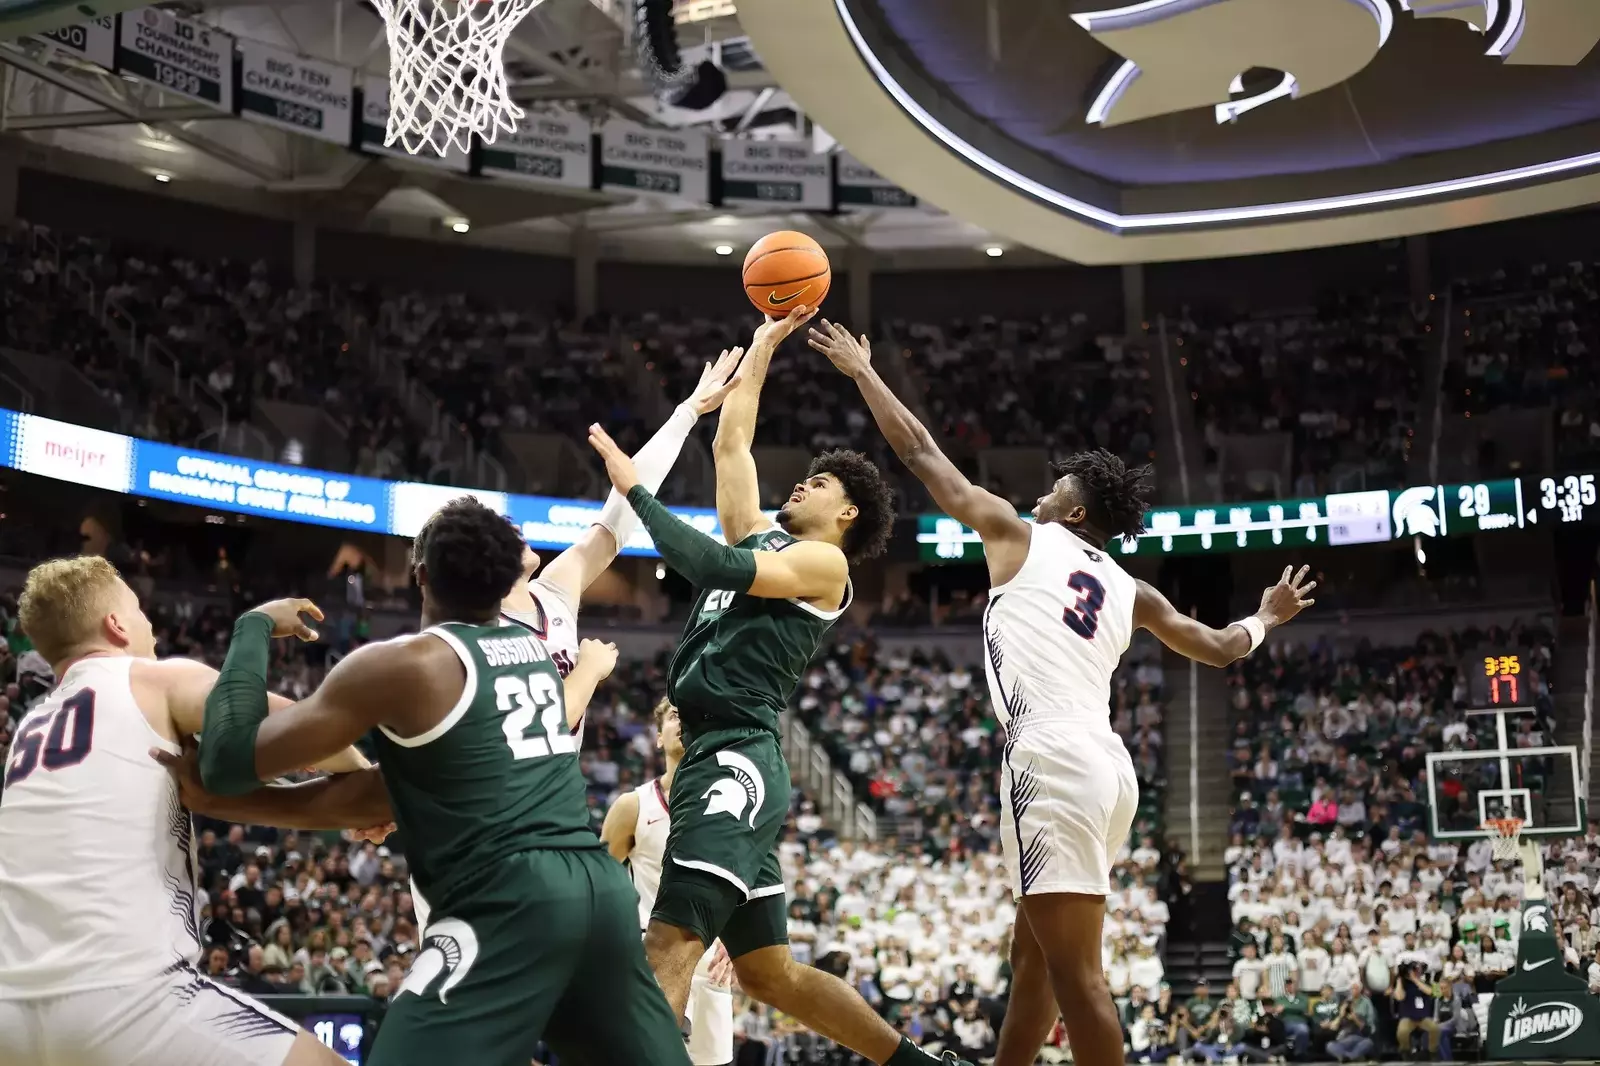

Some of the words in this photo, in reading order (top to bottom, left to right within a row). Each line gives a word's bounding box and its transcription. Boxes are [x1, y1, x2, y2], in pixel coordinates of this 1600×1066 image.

[135, 37, 221, 79] CHAMPIONS
[265, 58, 294, 78] BIG
[299, 66, 331, 88] TEN
[154, 62, 201, 96] 1999
[245, 69, 349, 110] CHAMPIONS
[44, 440, 106, 468] meijer
[1458, 483, 1490, 518] 29
[1540, 474, 1596, 510] 3:35
[1062, 569, 1107, 640] 3
[1484, 655, 1521, 676] 3:35
[1491, 674, 1518, 704] 17
[494, 672, 577, 761] 22
[4, 686, 97, 791] 50
[1502, 1008, 1577, 1048] LIBMAN
